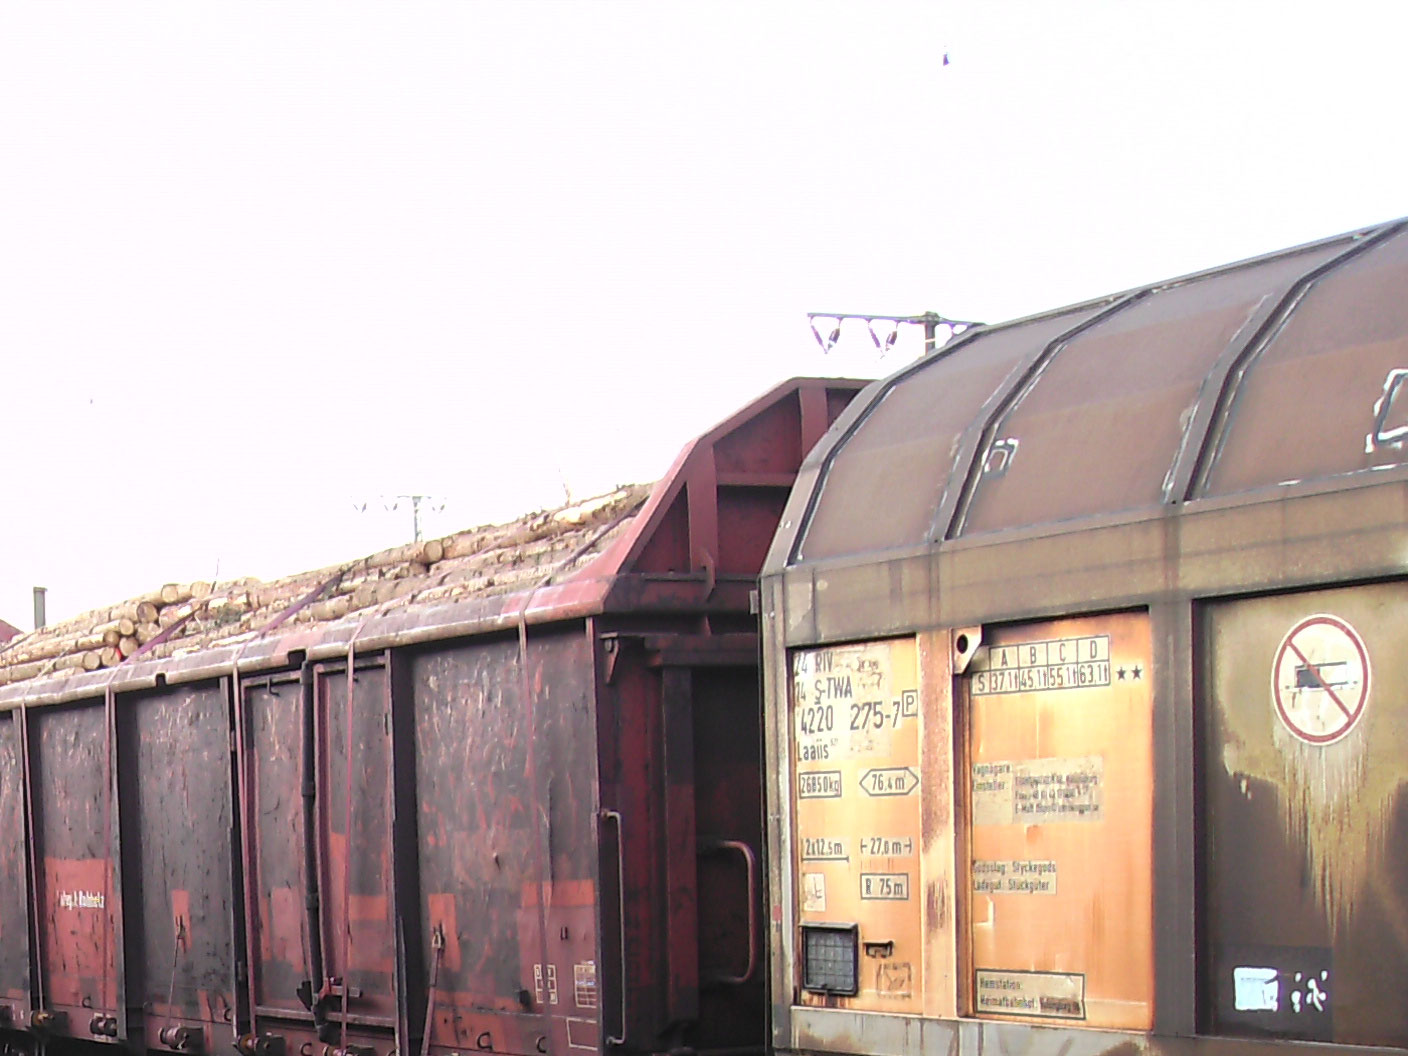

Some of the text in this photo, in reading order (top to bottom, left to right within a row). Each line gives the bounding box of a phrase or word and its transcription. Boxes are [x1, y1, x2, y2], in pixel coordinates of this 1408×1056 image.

[815, 650, 833, 673] RIV
[1001, 640, 1098, 667] A B C D
[978, 674, 986, 692] S
[801, 695, 915, 735] 4220 275-7 P
[879, 878, 892, 896] 75
